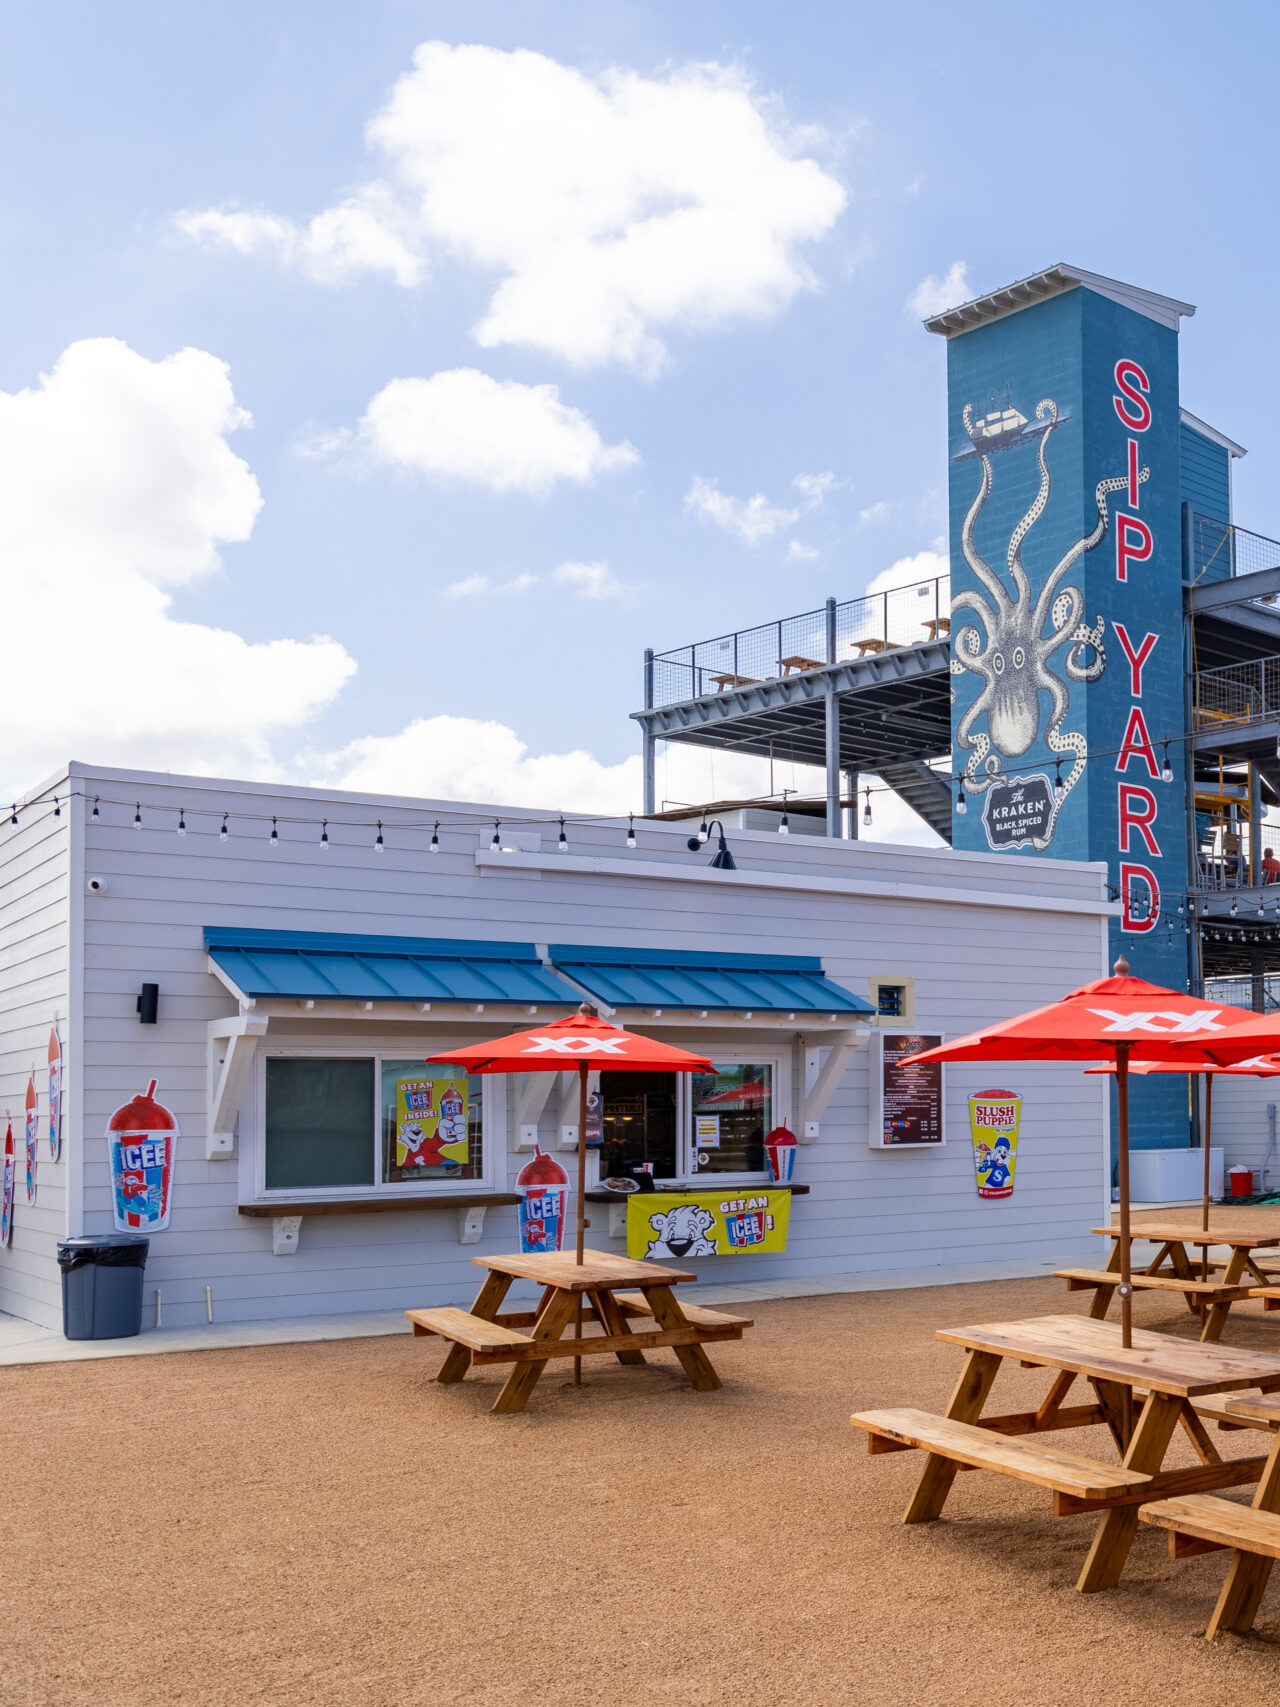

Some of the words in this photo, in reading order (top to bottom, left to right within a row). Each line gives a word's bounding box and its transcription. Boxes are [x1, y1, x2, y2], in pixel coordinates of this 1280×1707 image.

[1113, 358, 1153, 583] SIP
[1111, 621, 1163, 934] YARD
[1010, 788, 1024, 804] The
[993, 801, 1044, 819] KRAKEN
[996, 821, 1017, 831] BLACK
[1017, 816, 1042, 828] SPICED
[1011, 827, 1027, 837] RUM
[1084, 1007, 1227, 1033] XX
[520, 1036, 632, 1055] XX
[401, 1083, 418, 1091] GET
[420, 1081, 434, 1089] AN
[409, 1093, 429, 1107] ICEE
[404, 1110, 438, 1121] INSIDE!
[976, 1105, 1015, 1117] SLUSH
[120, 1143, 166, 1171] ICEE
[525, 1196, 561, 1220] ICEE
[719, 1199, 746, 1213] GET
[747, 1196, 769, 1210] AN
[731, 1216, 761, 1240] ICEE
